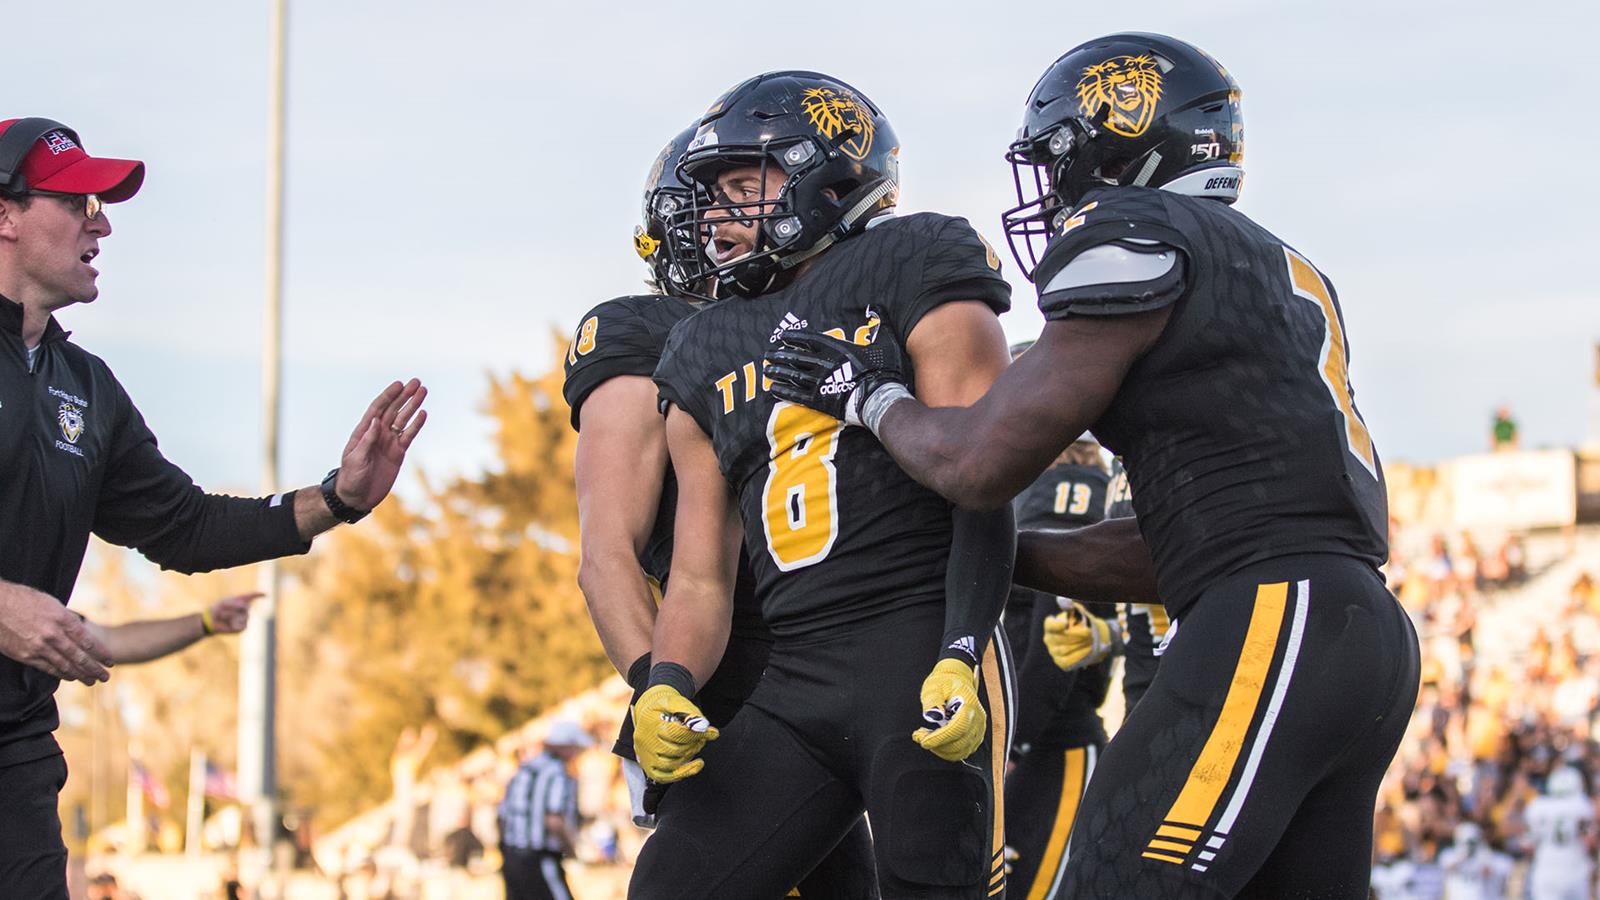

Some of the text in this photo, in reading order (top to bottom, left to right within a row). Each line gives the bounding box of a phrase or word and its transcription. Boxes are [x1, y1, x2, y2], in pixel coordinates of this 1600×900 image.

[1190, 142, 1220, 162] 150
[820, 381, 857, 395] adidas
[762, 402, 845, 572] 8
[1054, 481, 1092, 515] 13
